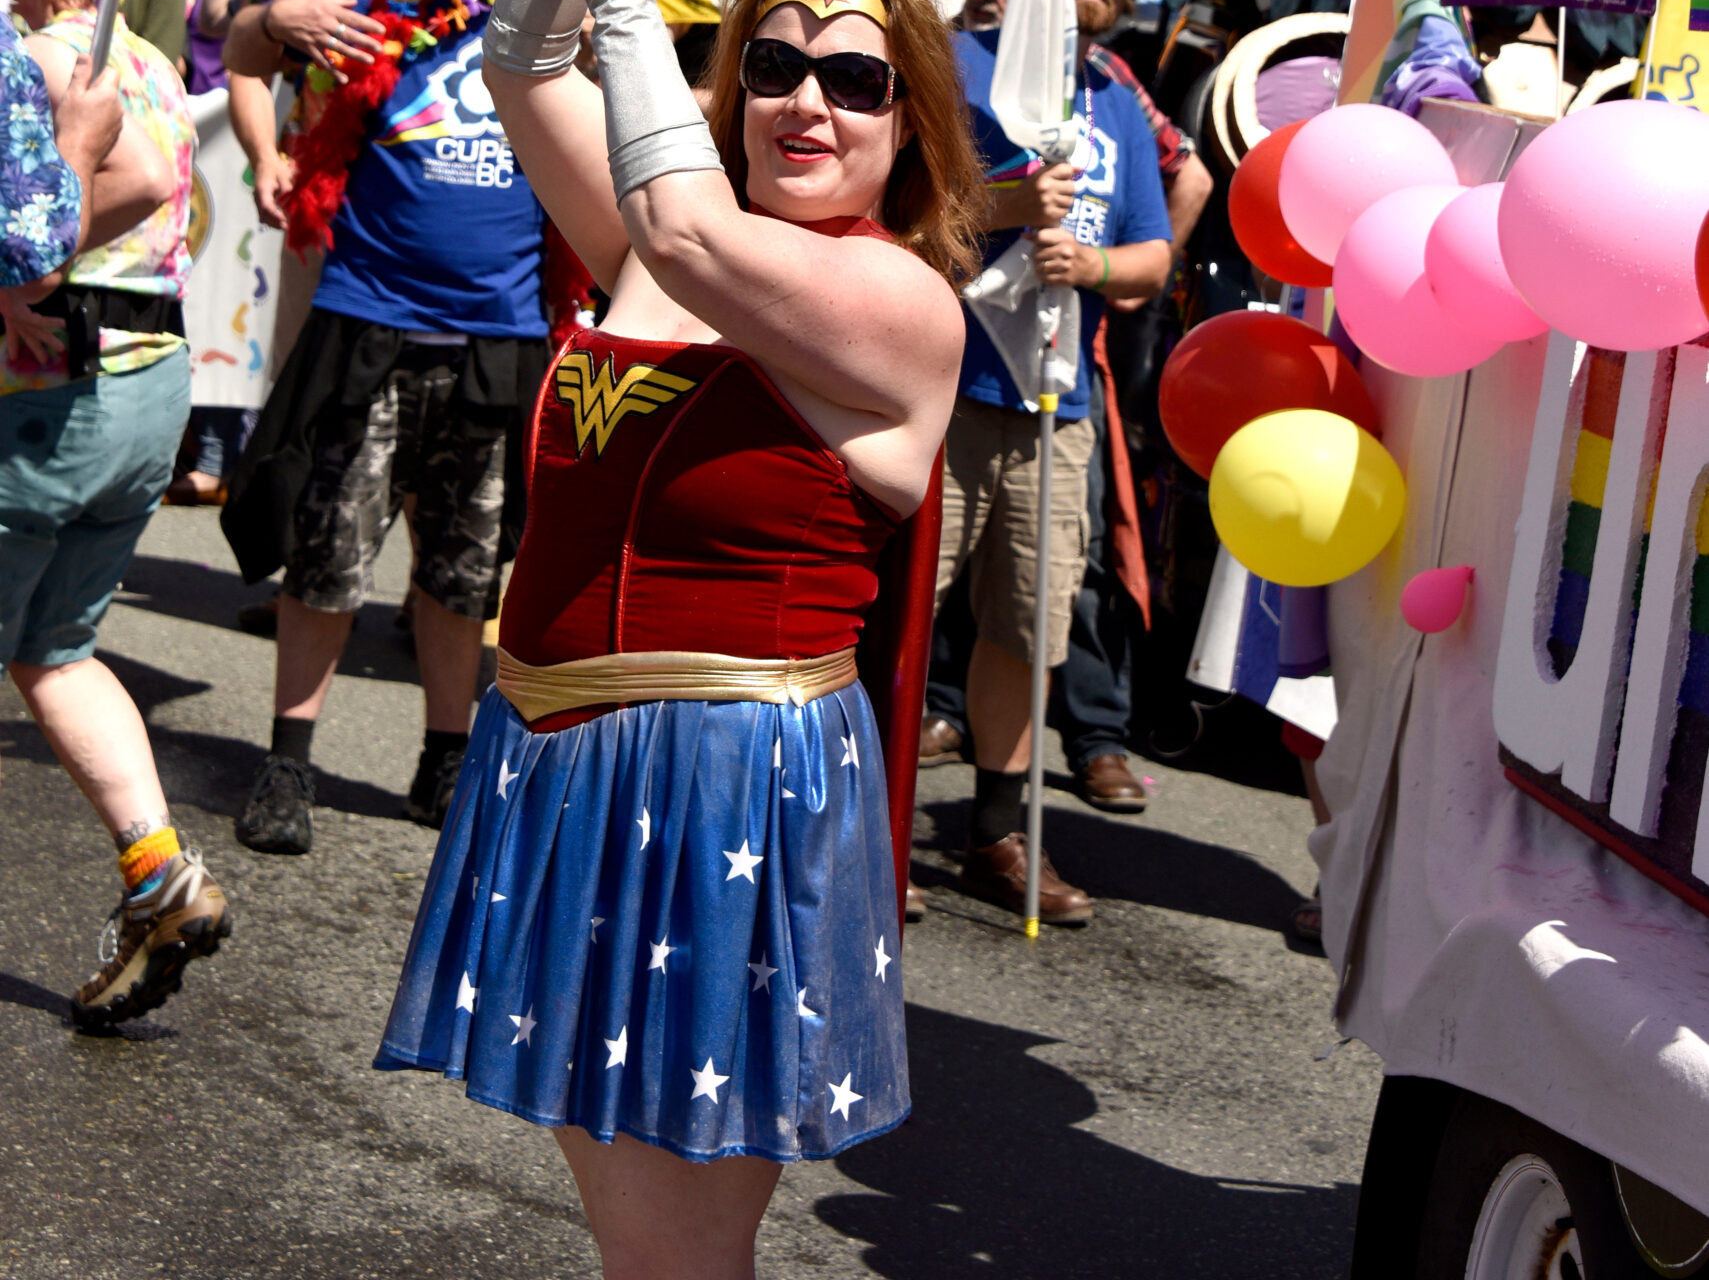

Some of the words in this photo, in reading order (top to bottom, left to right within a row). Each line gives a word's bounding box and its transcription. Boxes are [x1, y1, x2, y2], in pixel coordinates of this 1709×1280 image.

[436, 137, 514, 167] CUPE
[476, 162, 514, 189] BC
[1065, 198, 1109, 229] UPE
[1075, 220, 1104, 249] BC
